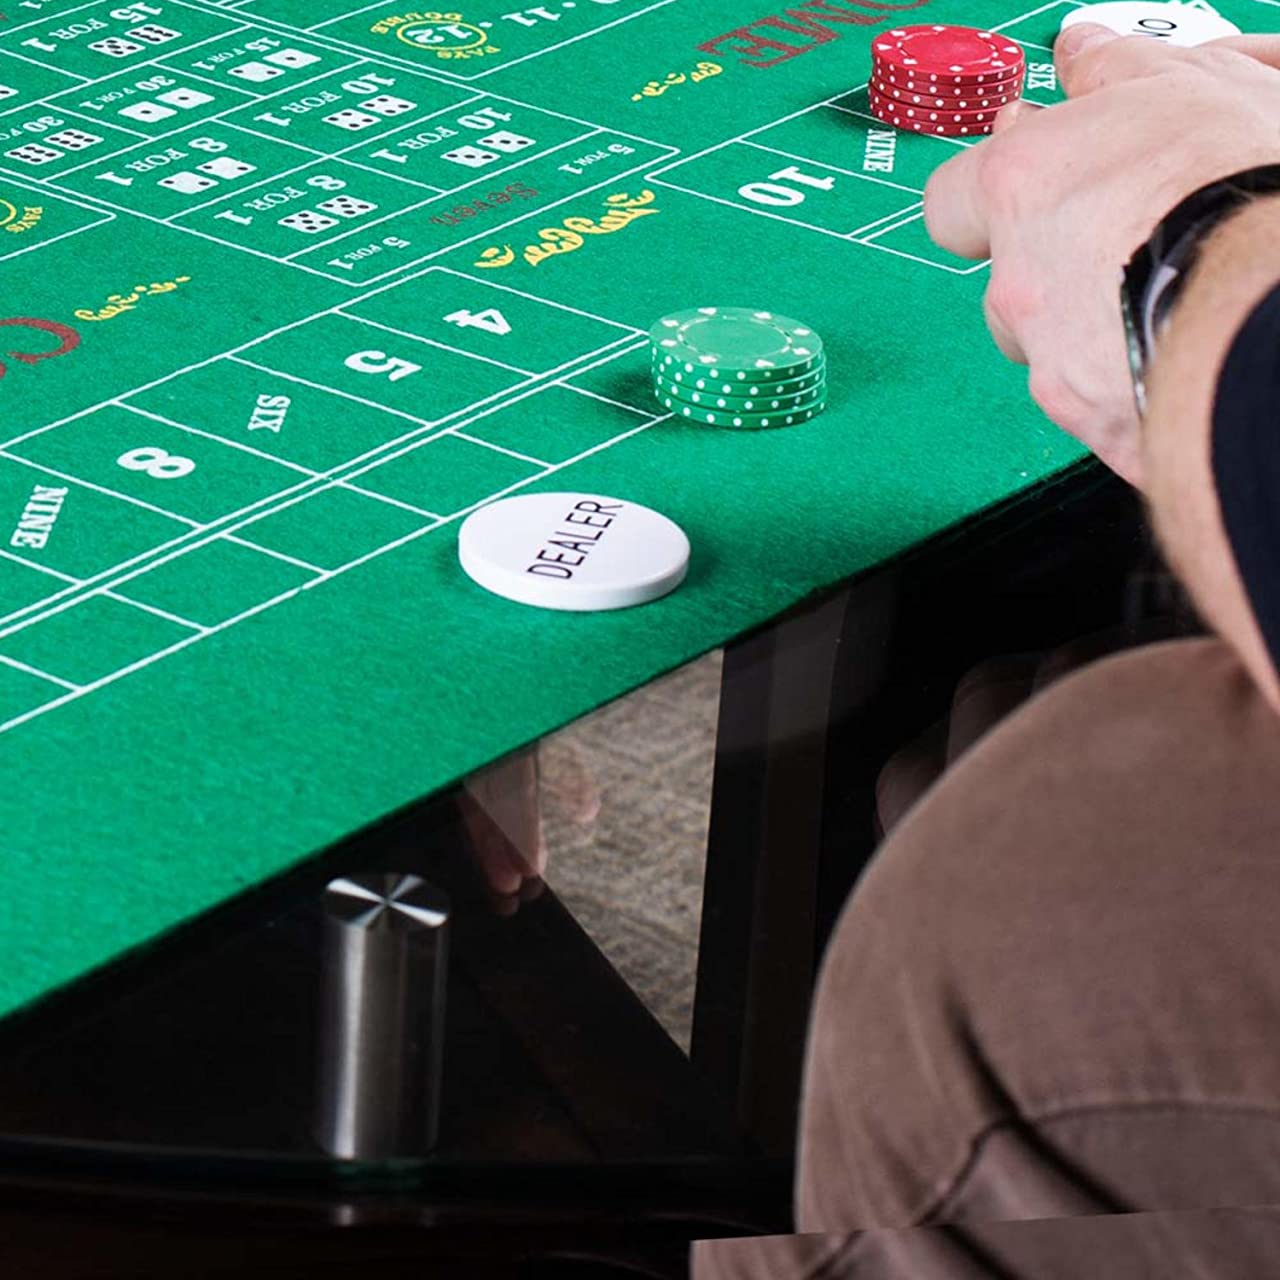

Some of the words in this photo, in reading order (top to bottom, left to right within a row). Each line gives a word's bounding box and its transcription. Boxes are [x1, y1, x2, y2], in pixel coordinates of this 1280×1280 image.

[110, 2, 162, 23] 15
[501, 6, 561, 27] 11
[48, 19, 109, 40] FOR
[406, 24, 472, 44] 12
[21, 37, 57, 52] 1
[244, 37, 280, 52] 15
[208, 48, 246, 63] FOR
[191, 61, 215, 71] 1
[135, 76, 176, 91] 30
[341, 72, 396, 94] 10
[1026, 63, 1056, 90] SIX
[96, 88, 136, 103] FOR
[281, 91, 342, 114] FOR
[79, 100, 104, 111] 1
[22, 116, 65, 133] 30
[253, 113, 291, 126] 1
[457, 107, 513, 130] 10
[188, 137, 228, 152] 8
[396, 126, 459, 151] FOR
[369, 148, 409, 163] 1
[583, 152, 611, 166] FOR
[607, 144, 636, 156] 5
[863, 129, 897, 172] NINE
[125, 148, 188, 172] FOR
[95, 171, 133, 186] 1
[558, 164, 583, 176] 1
[307, 175, 346, 190] 8
[737, 166, 836, 207] 10
[243, 186, 307, 211] FOR
[429, 182, 539, 227] Seven
[214, 210, 253, 225] 1
[383, 236, 411, 249] 5
[344, 244, 382, 262] FOR
[327, 257, 354, 271] 1
[442, 308, 512, 335] 4
[344, 350, 422, 382] 5
[248, 394, 291, 432] SIX
[117, 447, 196, 479] 8
[10, 485, 69, 549] NINE
[527, 500, 623, 579] DEALER
